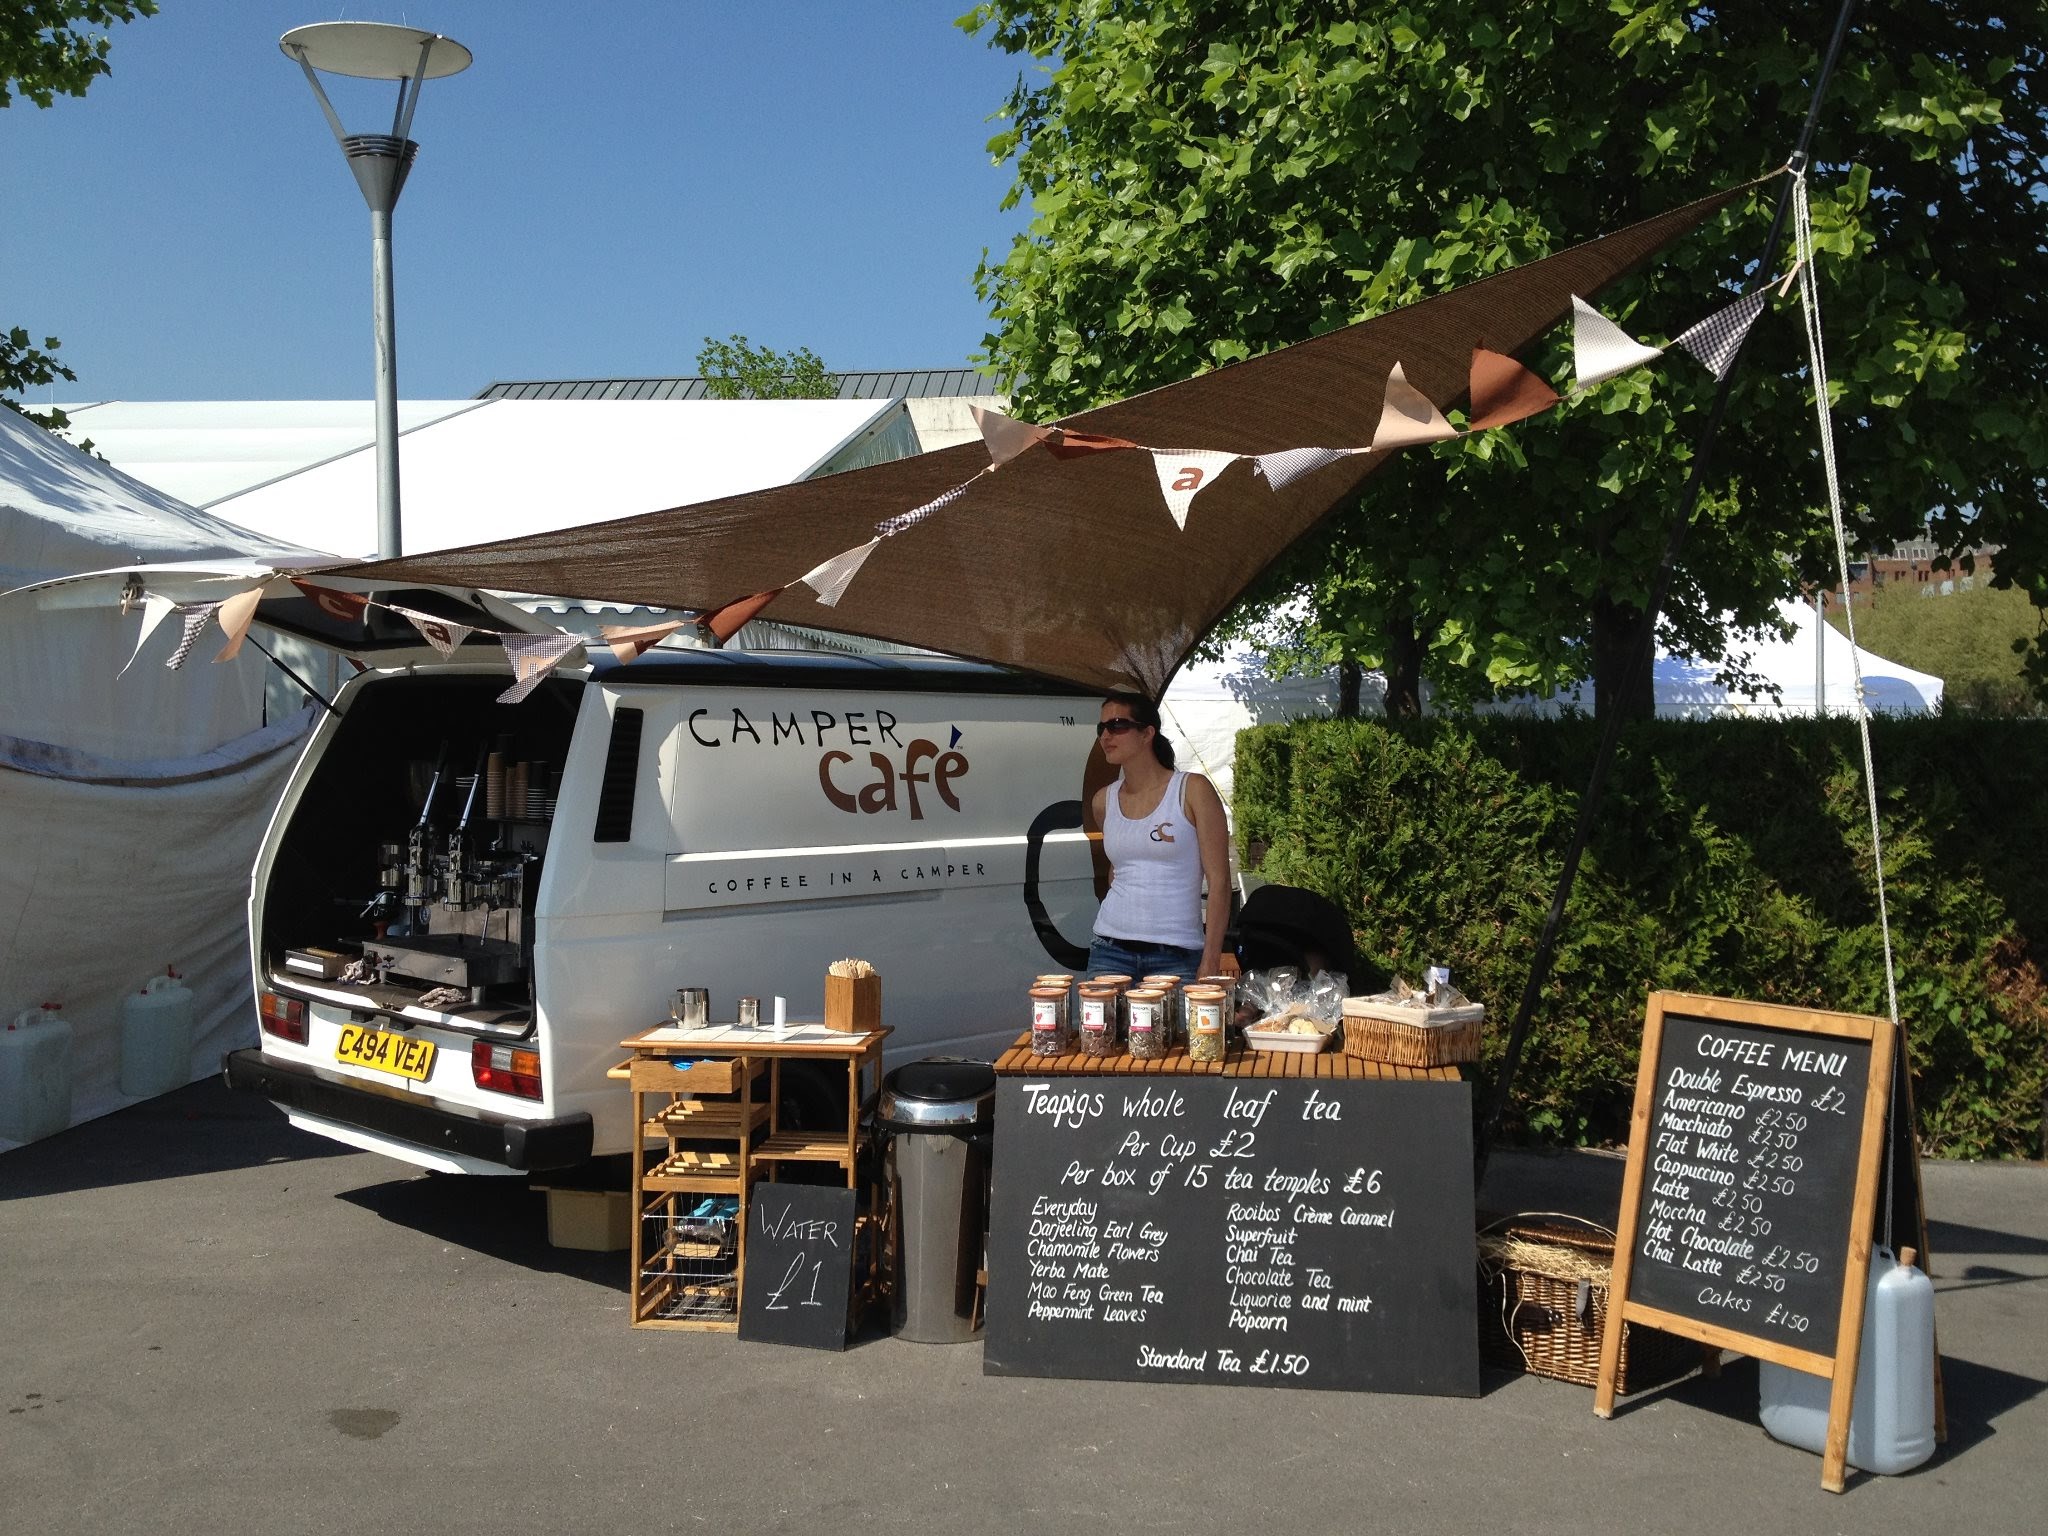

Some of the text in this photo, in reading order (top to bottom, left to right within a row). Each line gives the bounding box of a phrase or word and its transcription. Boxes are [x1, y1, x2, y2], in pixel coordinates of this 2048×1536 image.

[1171, 467, 1204, 492] a
[688, 708, 903, 748] CAMPER
[708, 863, 985, 894] COFFEE IN A CAMPER
[338, 1028, 428, 1075] C494 VEA
[1697, 1034, 1848, 1078] COFFEE MENU
[1662, 1088, 1746, 1120] Americano
[1667, 1066, 1847, 1115] Double Espresso £2
[1022, 1083, 1342, 1129] Teapigs whole leaf tea
[1658, 1112, 1733, 1139] Macchiato
[1118, 1129, 1256, 1163] Per Cup £2
[1656, 1132, 1689, 1155] Flat
[1696, 1137, 1740, 1164] White
[1060, 1160, 1383, 1202] Per box of 15 tea temples £6
[1653, 1153, 1735, 1186] Cappuccino
[1651, 1174, 1690, 1201] Latte
[760, 1202, 839, 1249] WATER
[1031, 1196, 1098, 1225] Everyday
[1226, 1201, 1395, 1228] Rooibos Crème Caramel
[1648, 1198, 1707, 1225] Moccha
[1028, 1218, 1169, 1247] Darjeeling Earl Grey
[1225, 1224, 1298, 1248] Superfruit
[1645, 1217, 1673, 1242] Hot
[1680, 1226, 1755, 1260] Chocolate
[1027, 1238, 1160, 1263] Chamomile Flowers
[1226, 1244, 1297, 1266] Chai Tea
[1643, 1238, 1676, 1263] Chai
[1682, 1250, 1723, 1277] Latte
[765, 1251, 823, 1310] £1
[1029, 1259, 1111, 1279] Yerba Mate
[1226, 1265, 1334, 1290] Chocolate Tea
[1027, 1281, 1164, 1307] Mao Feng Green Tea
[1230, 1285, 1373, 1315] Liquorice and mint
[1697, 1286, 1753, 1313] Cakes
[1027, 1300, 1147, 1322] Peppermint Leaves
[1228, 1309, 1289, 1333] Popcorn
[1136, 1344, 1310, 1376] Standard Tea £1.50
